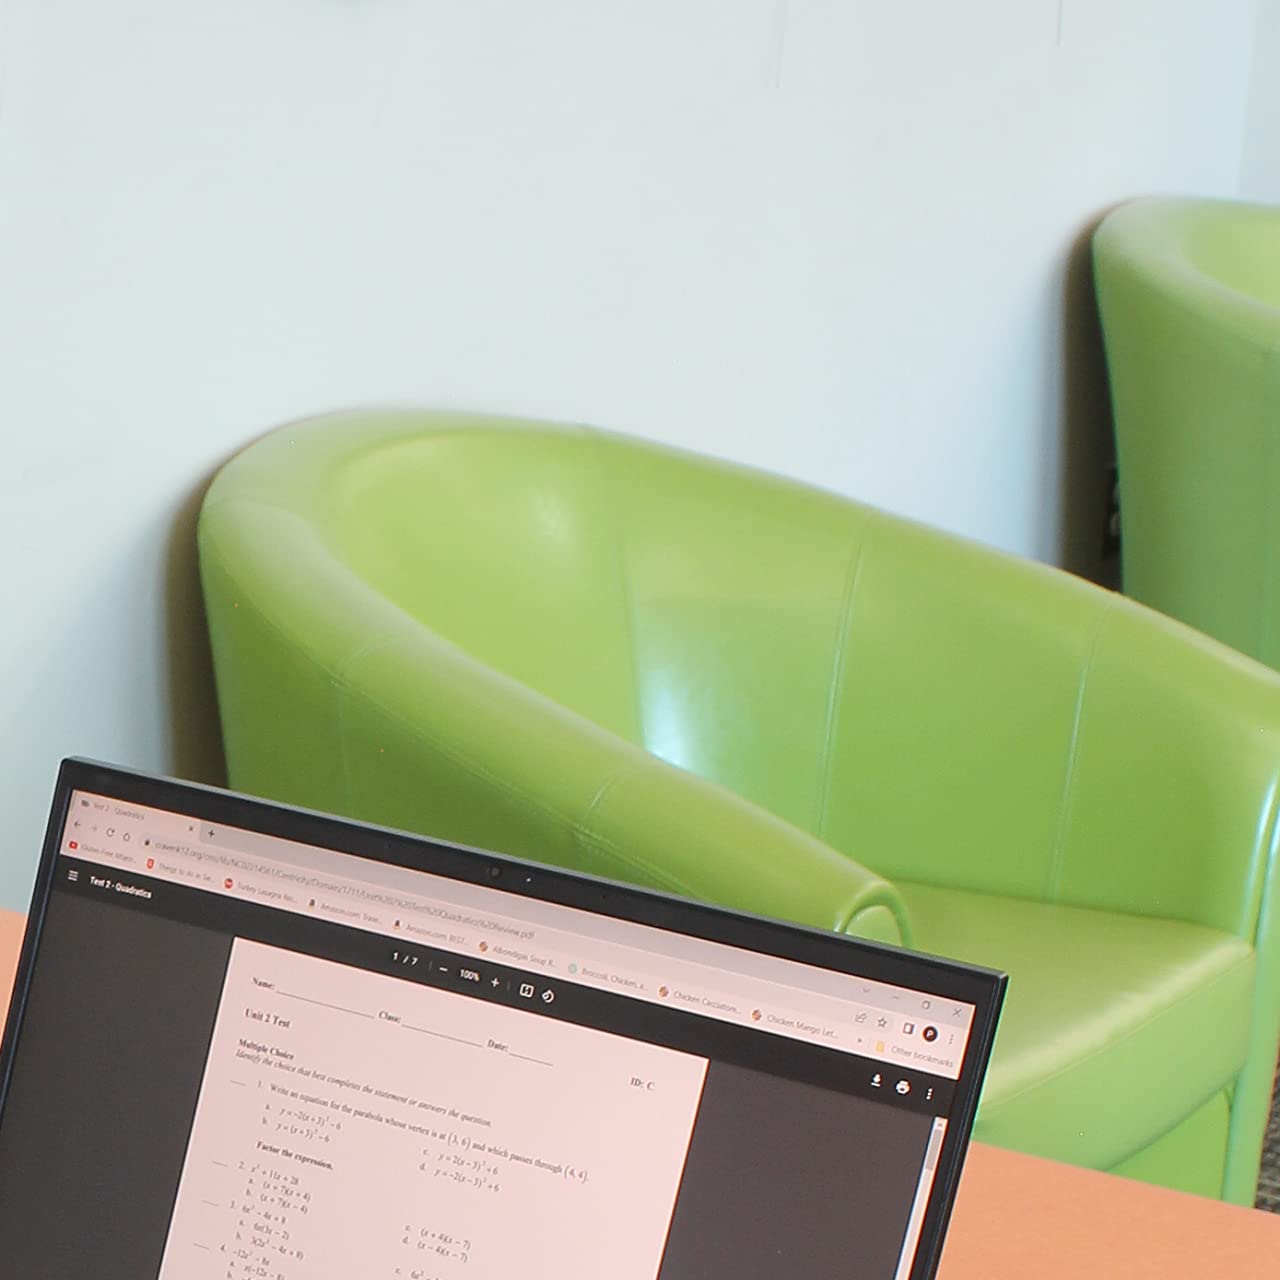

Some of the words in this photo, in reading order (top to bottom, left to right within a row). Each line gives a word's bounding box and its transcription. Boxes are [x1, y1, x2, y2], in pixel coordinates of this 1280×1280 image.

[89, 875, 105, 887] Test
[104, 879, 111, 889] 2
[114, 881, 152, 899] Quadratics
[392, 951, 398, 961] 1
[411, 956, 418, 966] 7
[459, 968, 480, 982] 100%
[251, 976, 275, 990] Name:
[244, 1008, 263, 1021] Unit
[264, 1013, 271, 1023] 2
[271, 1015, 291, 1028] Test
[377, 1009, 401, 1024] Class:
[238, 1038, 268, 1054] Multiple
[269, 1047, 294, 1060] Choice
[487, 1038, 509, 1052] Date:
[629, 1076, 645, 1088] ID:
[646, 1080, 655, 1091] C
[256, 1141, 280, 1155] Factor
[281, 1148, 293, 1159] the
[293, 1152, 334, 1171] expression.
